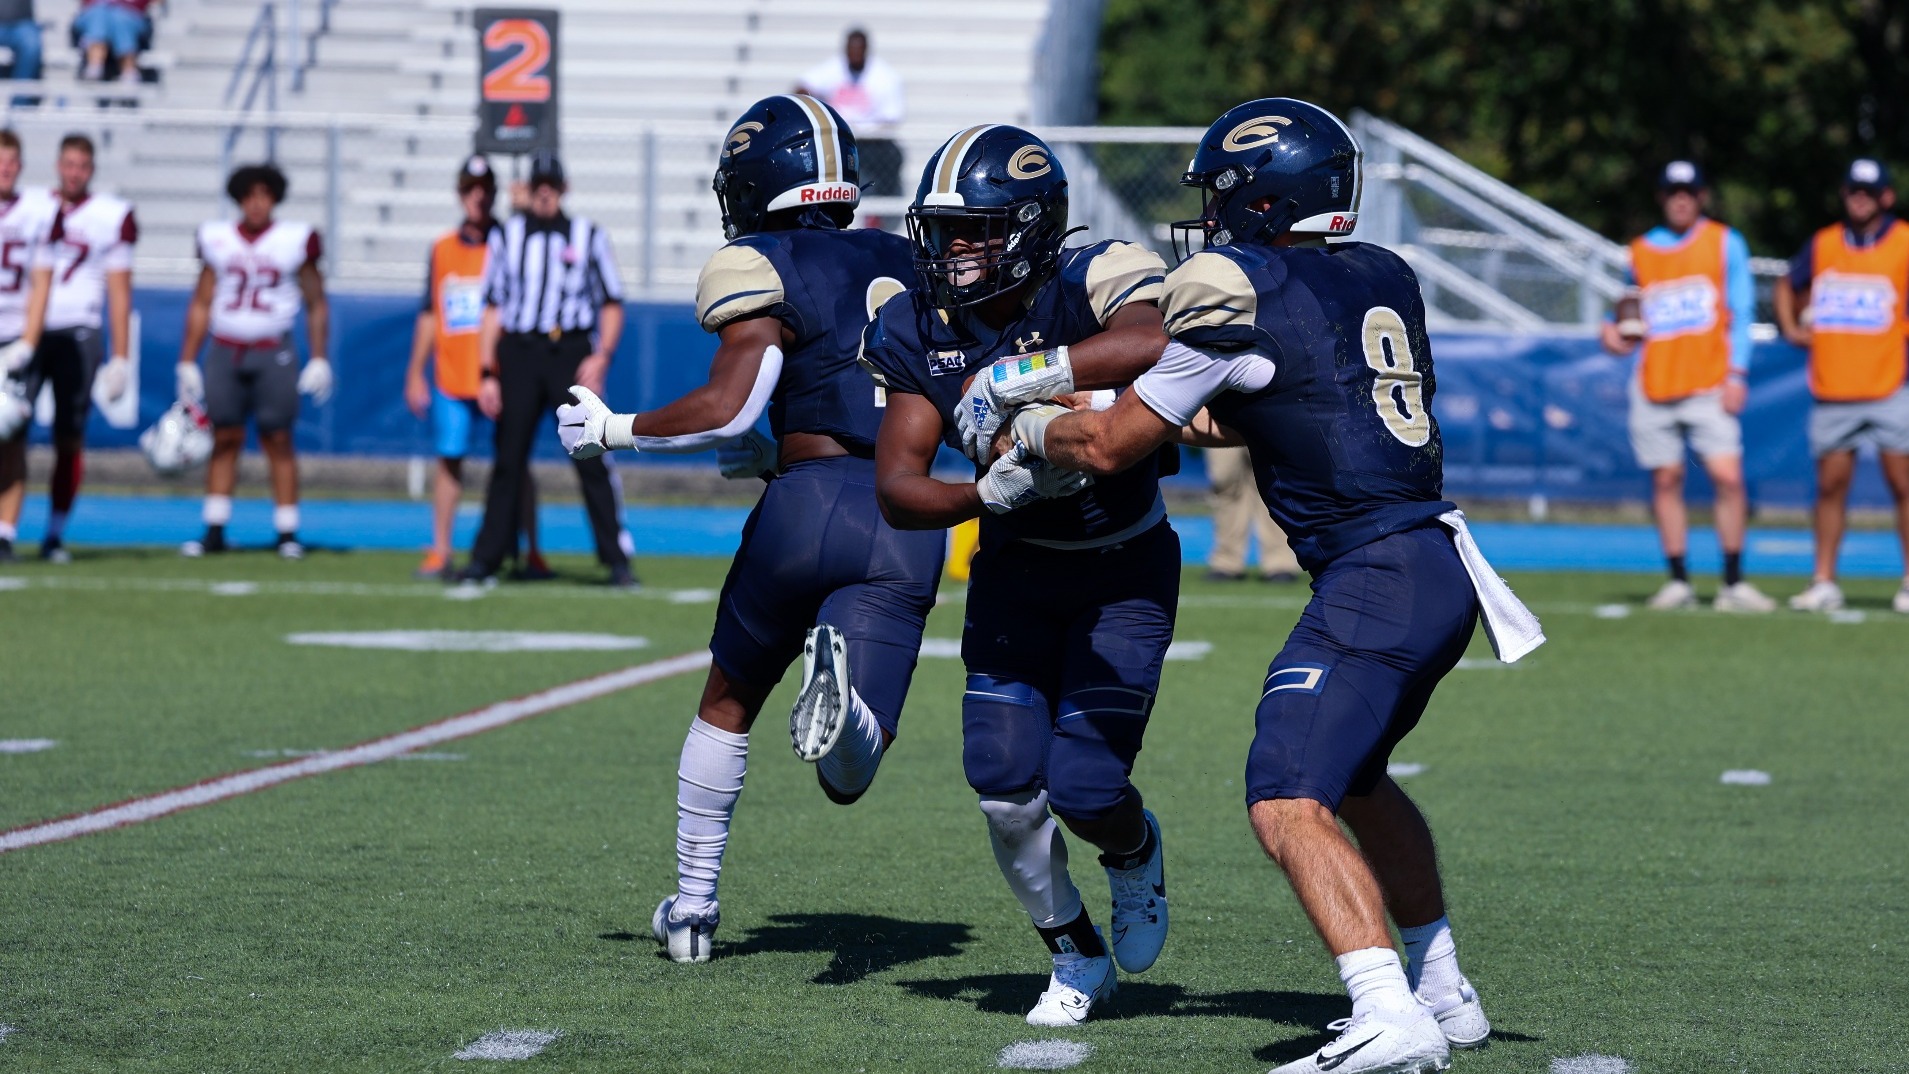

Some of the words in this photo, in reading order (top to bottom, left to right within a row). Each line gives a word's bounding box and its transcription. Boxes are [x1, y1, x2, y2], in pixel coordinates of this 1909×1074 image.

[483, 18, 551, 102] 2
[800, 187, 857, 203] Riddell
[1328, 215, 1357, 231] Rid
[63, 241, 89, 284] 7
[224, 265, 281, 312] 32
[929, 355, 963, 370] PSAC
[1361, 306, 1430, 448] 8
